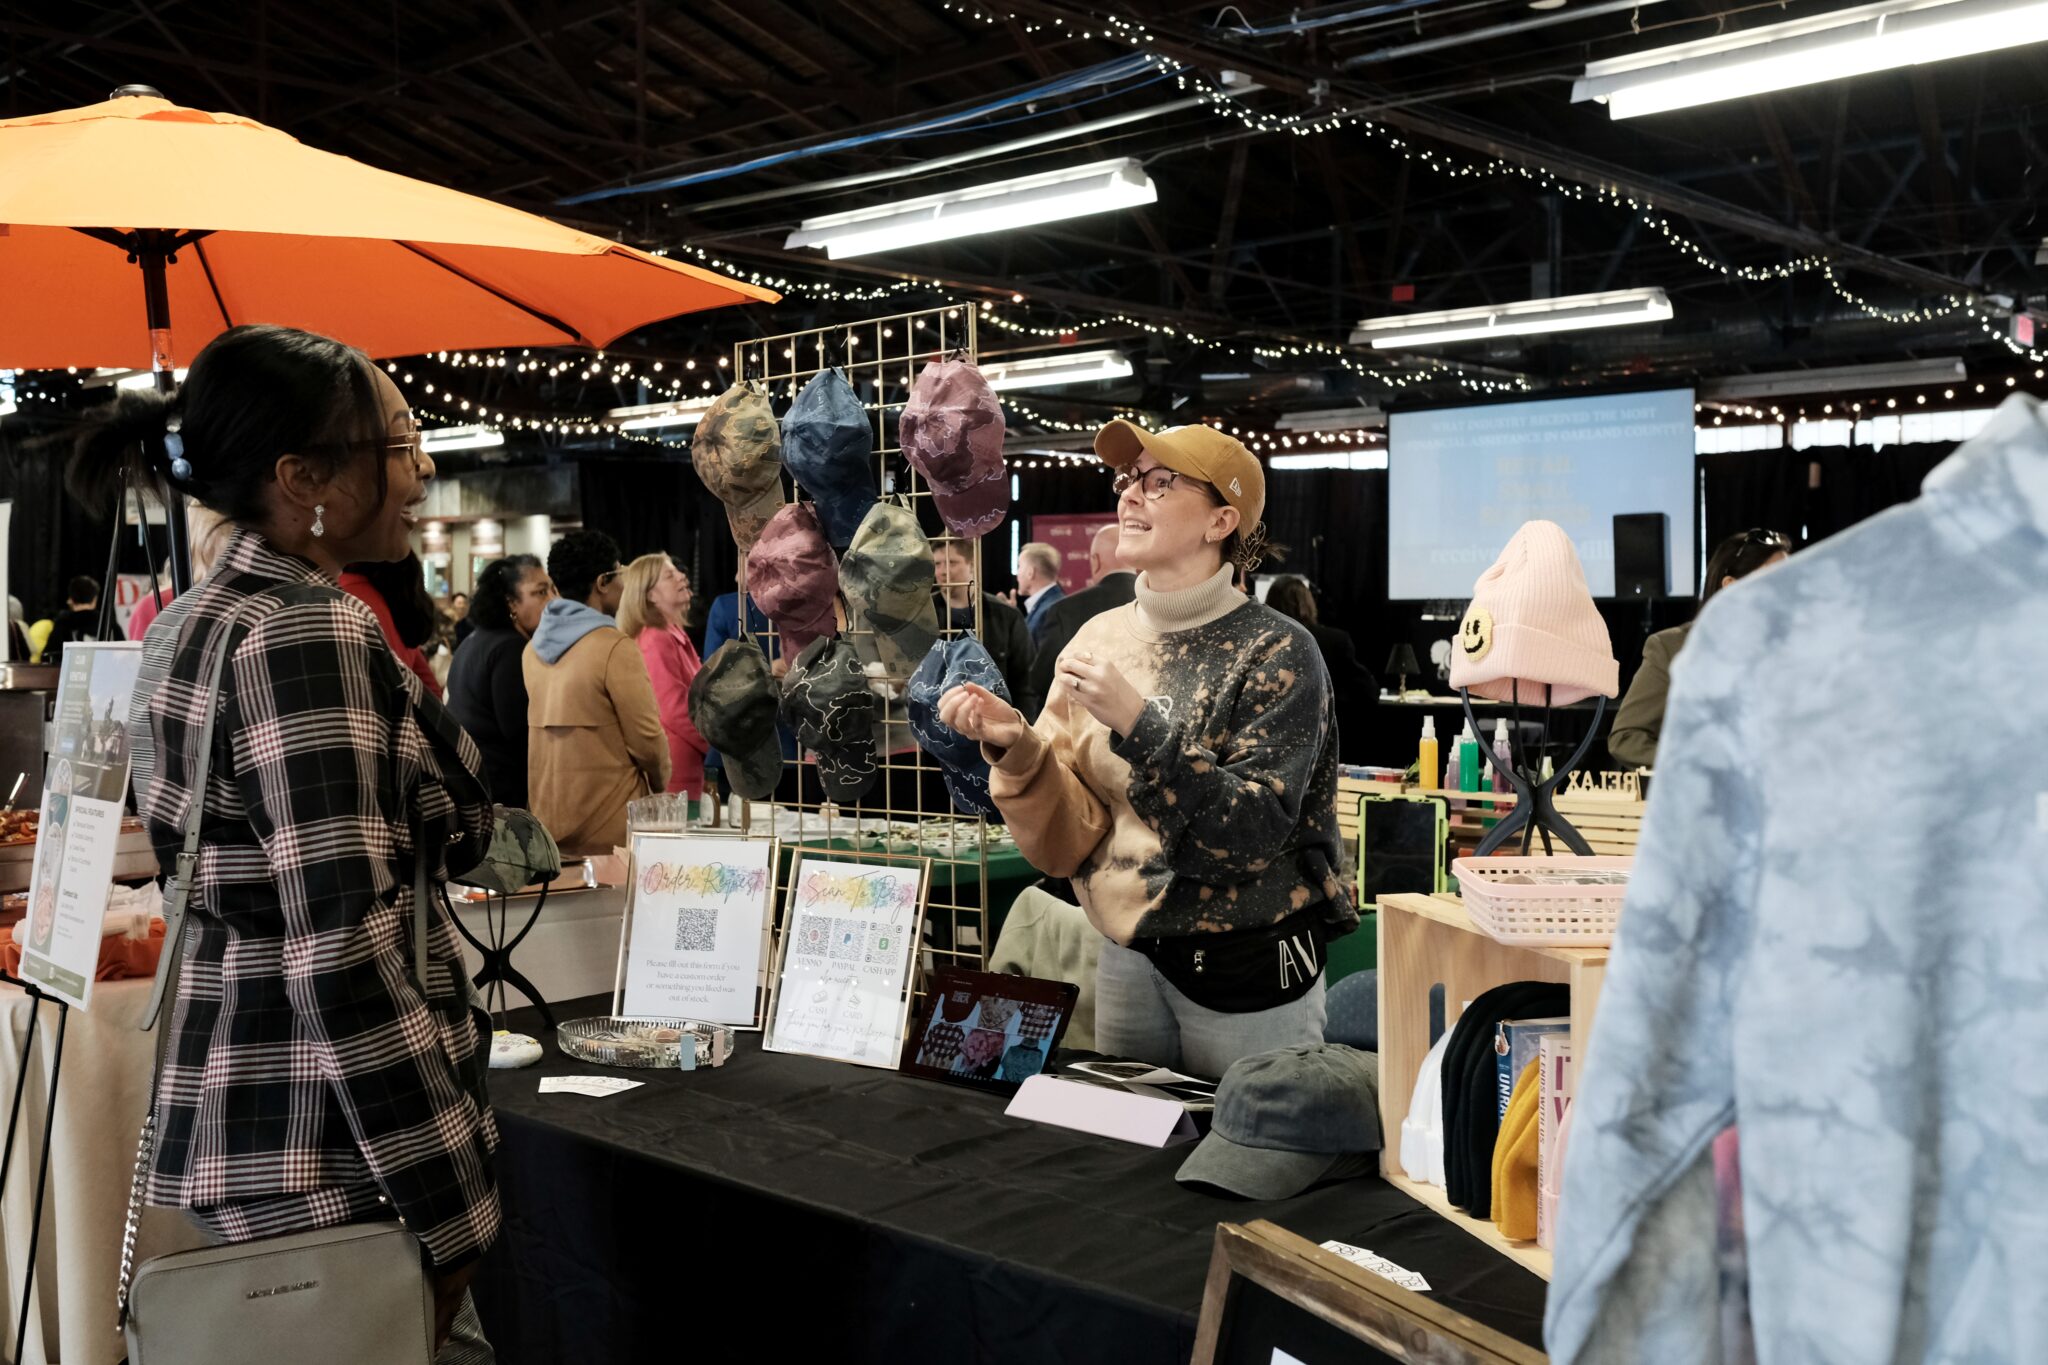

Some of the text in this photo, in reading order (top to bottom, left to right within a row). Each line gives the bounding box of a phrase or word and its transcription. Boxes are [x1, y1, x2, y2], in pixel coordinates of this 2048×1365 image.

[1531, 411, 1589, 427] RECEIVED
[1593, 409, 1618, 423] THE
[1620, 407, 1658, 421] MOST
[1544, 430, 1558, 444] IN
[1562, 426, 1621, 442] OAKLAND
[644, 861, 766, 904] Order Request
[805, 870, 911, 925] Scan To Pay
[646, 959, 667, 968] Please
[668, 960, 676, 968] fill
[690, 961, 703, 970] this
[703, 961, 720, 971] form
[832, 961, 856, 972] PAYPAL
[657, 970, 673, 979] have
[680, 973, 706, 981] custom
[863, 966, 897, 977] CASH APP
[655, 983, 691, 993] something
[690, 985, 705, 993] you
[705, 984, 722, 993] liked
